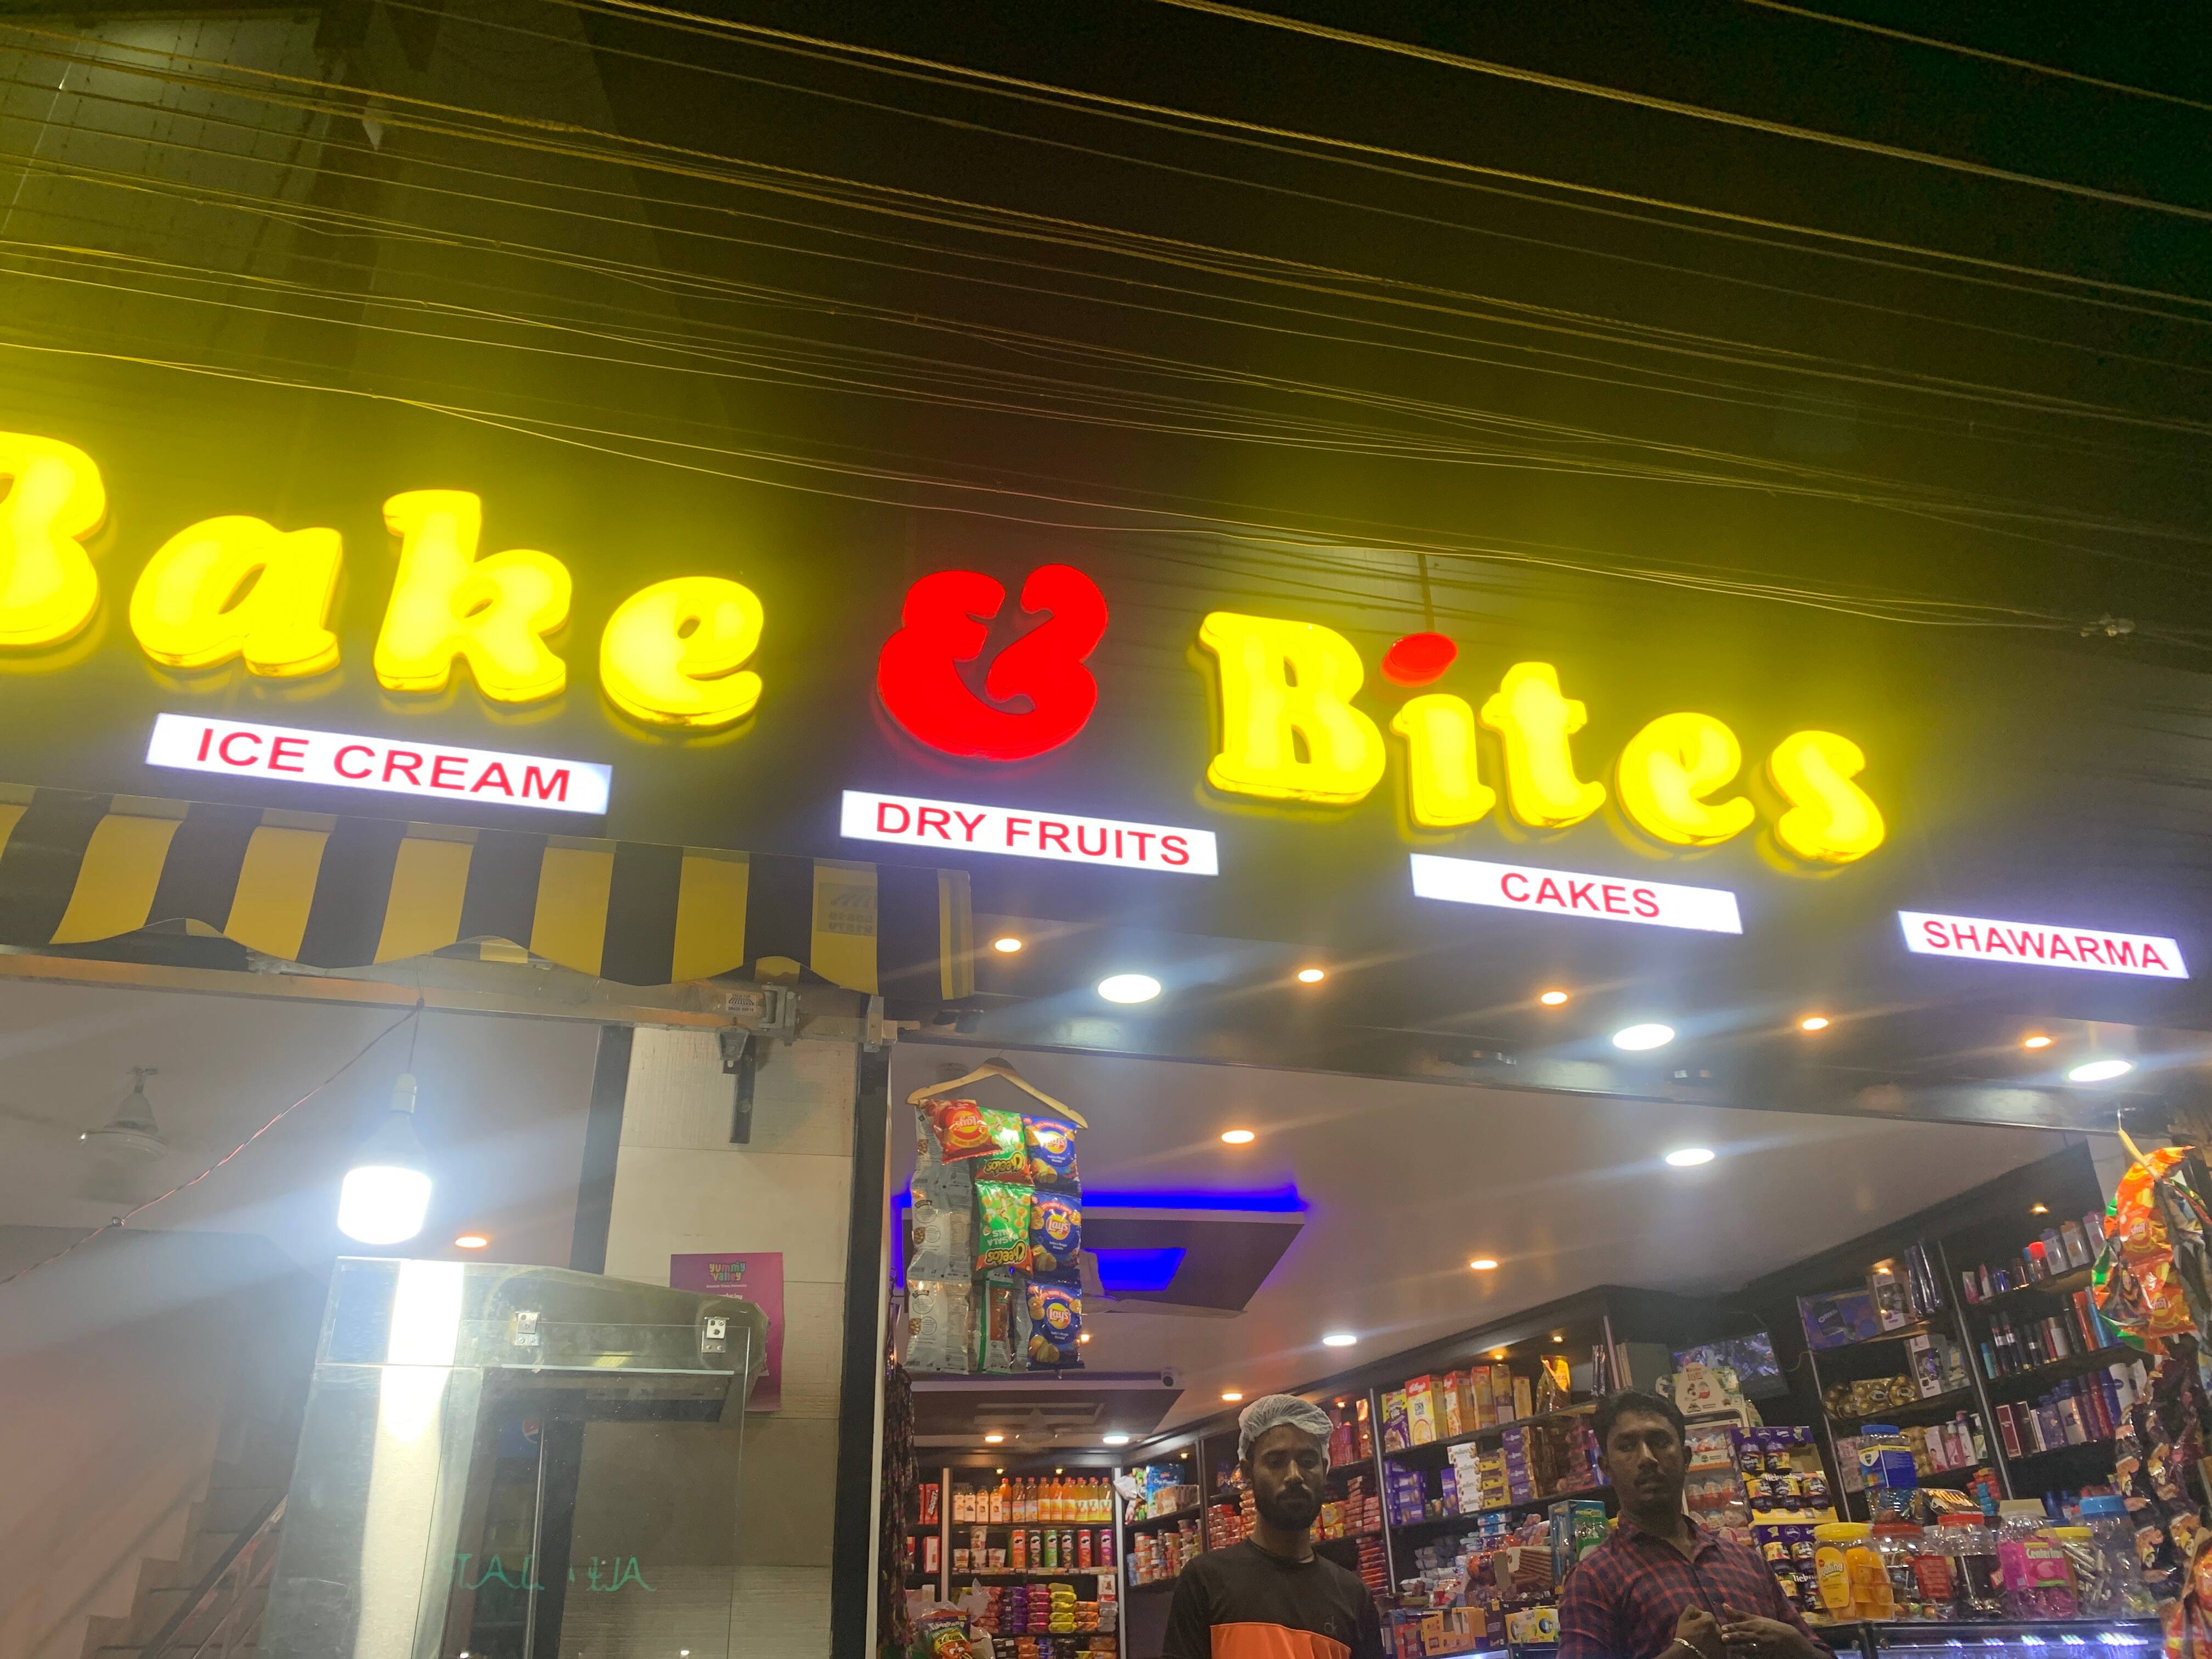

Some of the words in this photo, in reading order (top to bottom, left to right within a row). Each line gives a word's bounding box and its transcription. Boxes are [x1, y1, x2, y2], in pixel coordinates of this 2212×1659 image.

[879, 563, 1108, 761] &
[1199, 612, 1886, 864] Bites
[196, 729, 309, 773] ICE
[334, 744, 570, 802] CREAM
[877, 802, 987, 842] DRY
[1005, 816, 1190, 866] FRUITS
[1500, 872, 1660, 918] CAKES
[1922, 920, 2169, 970] SHAWARMA
[985, 1240, 1026, 1265] Cheetos
